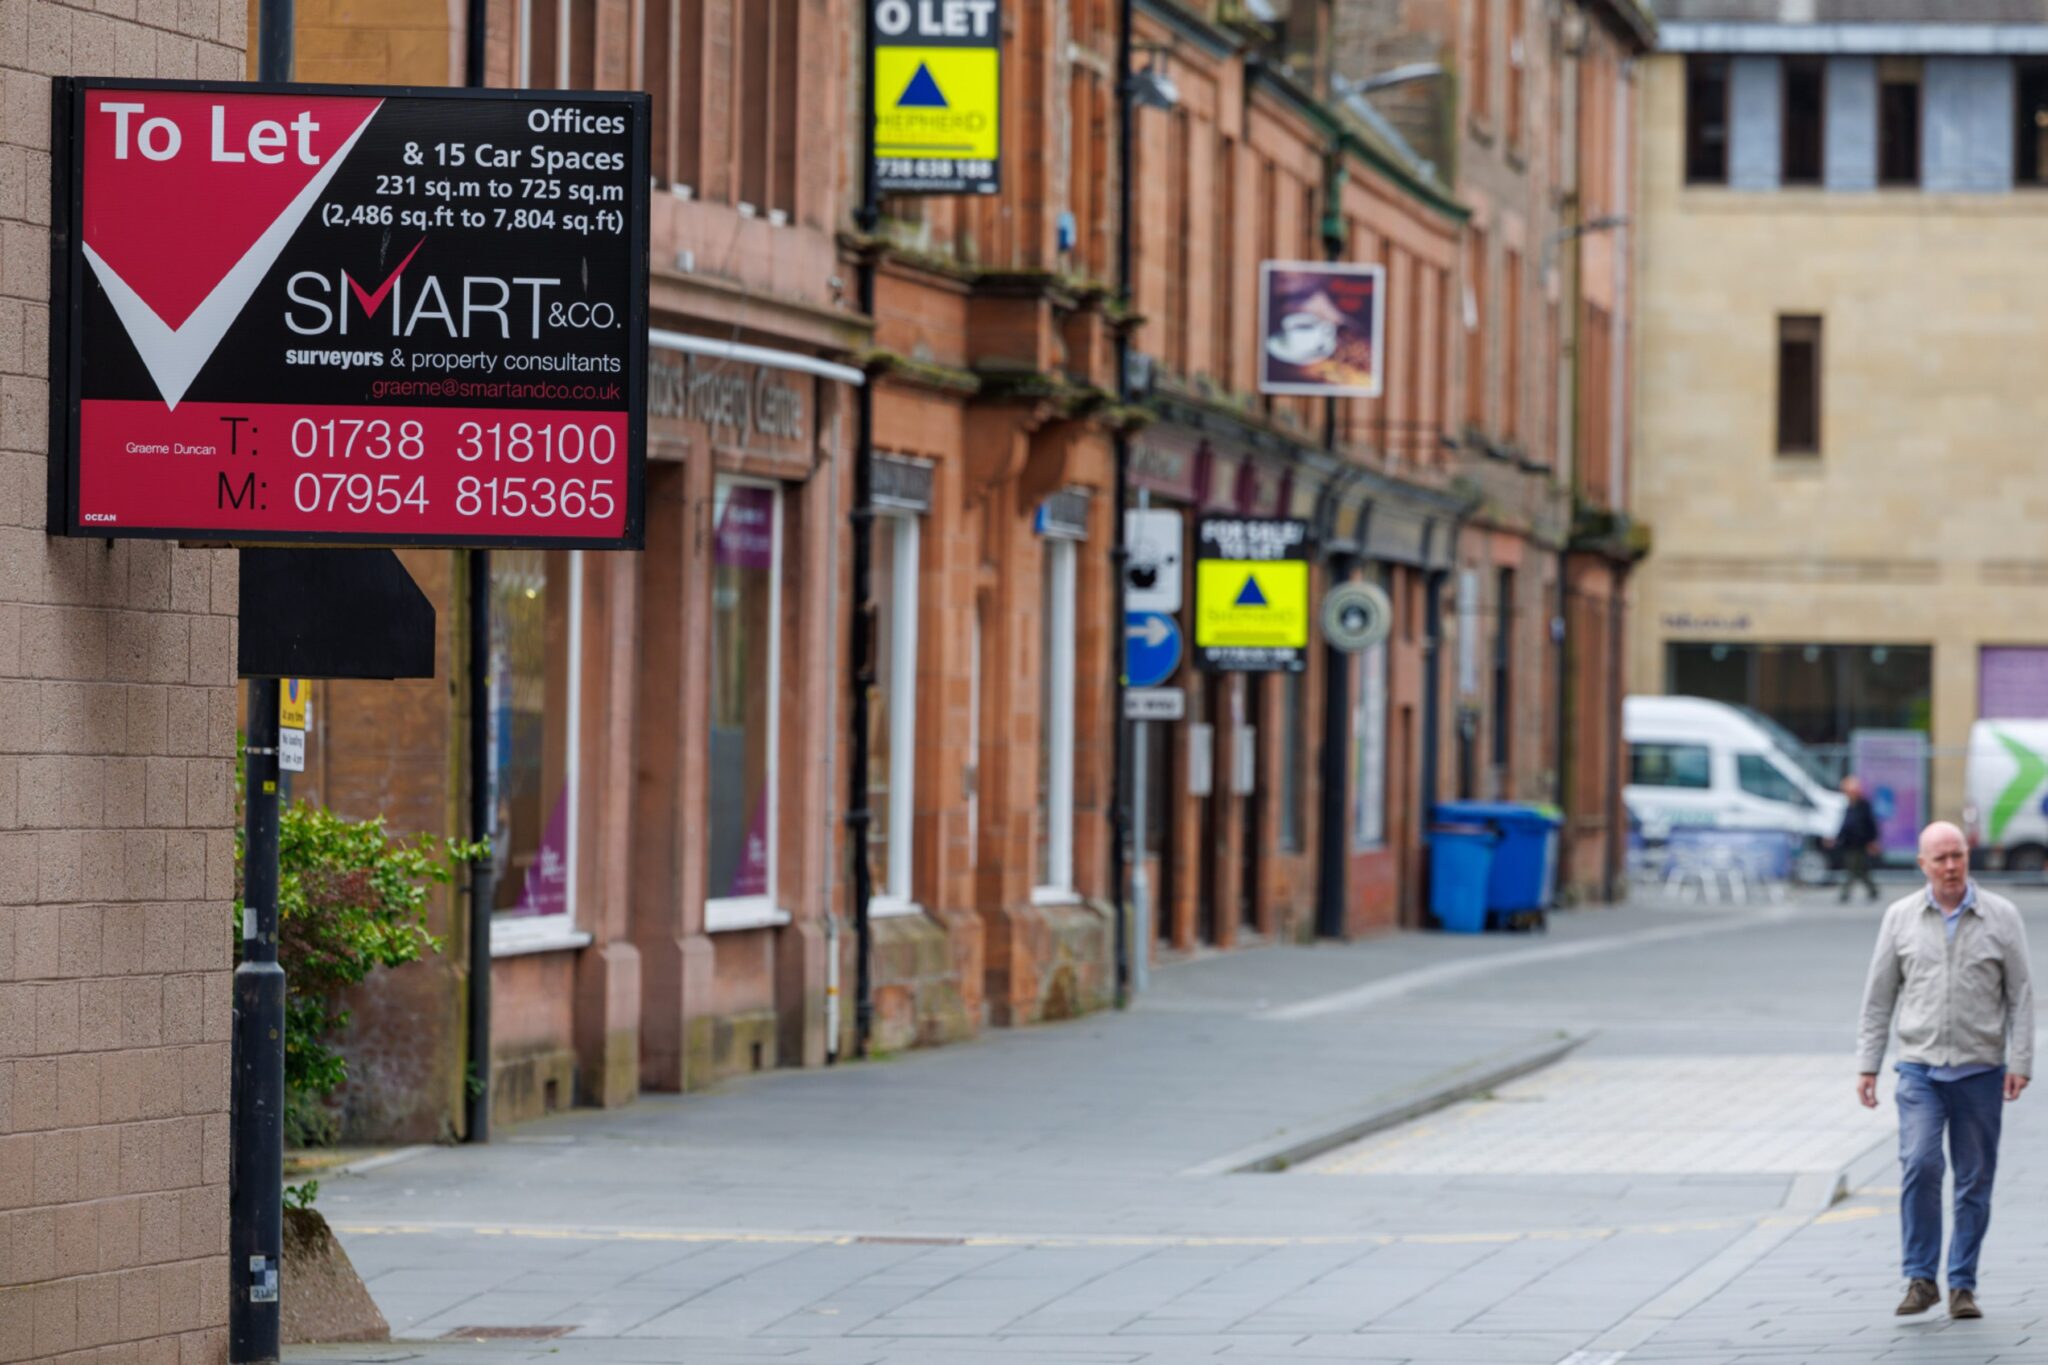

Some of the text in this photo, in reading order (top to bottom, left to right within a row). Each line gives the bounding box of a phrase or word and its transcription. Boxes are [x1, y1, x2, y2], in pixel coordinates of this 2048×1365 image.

[875, 0, 995, 36] O LET
[100, 102, 320, 165] To Let
[528, 108, 624, 133] Offices
[404, 142, 624, 174] & 15 Car Spaces
[377, 175, 623, 204] 231 sq.m to 725 sq.m
[322, 203, 623, 235] (2,486 sq.ft to 7,804 sq.ft)
[285, 268, 622, 338] SMART &CO.
[286, 349, 621, 374] surveyors & property consultants
[372, 378, 620, 399] graeme@smartandco.co.uk
[126, 442, 216, 455] Graeme Duncan
[220, 416, 616, 465] T: 01738 318100
[217, 471, 615, 518] M: 07954 815365
[85, 513, 116, 522] OCEAN
